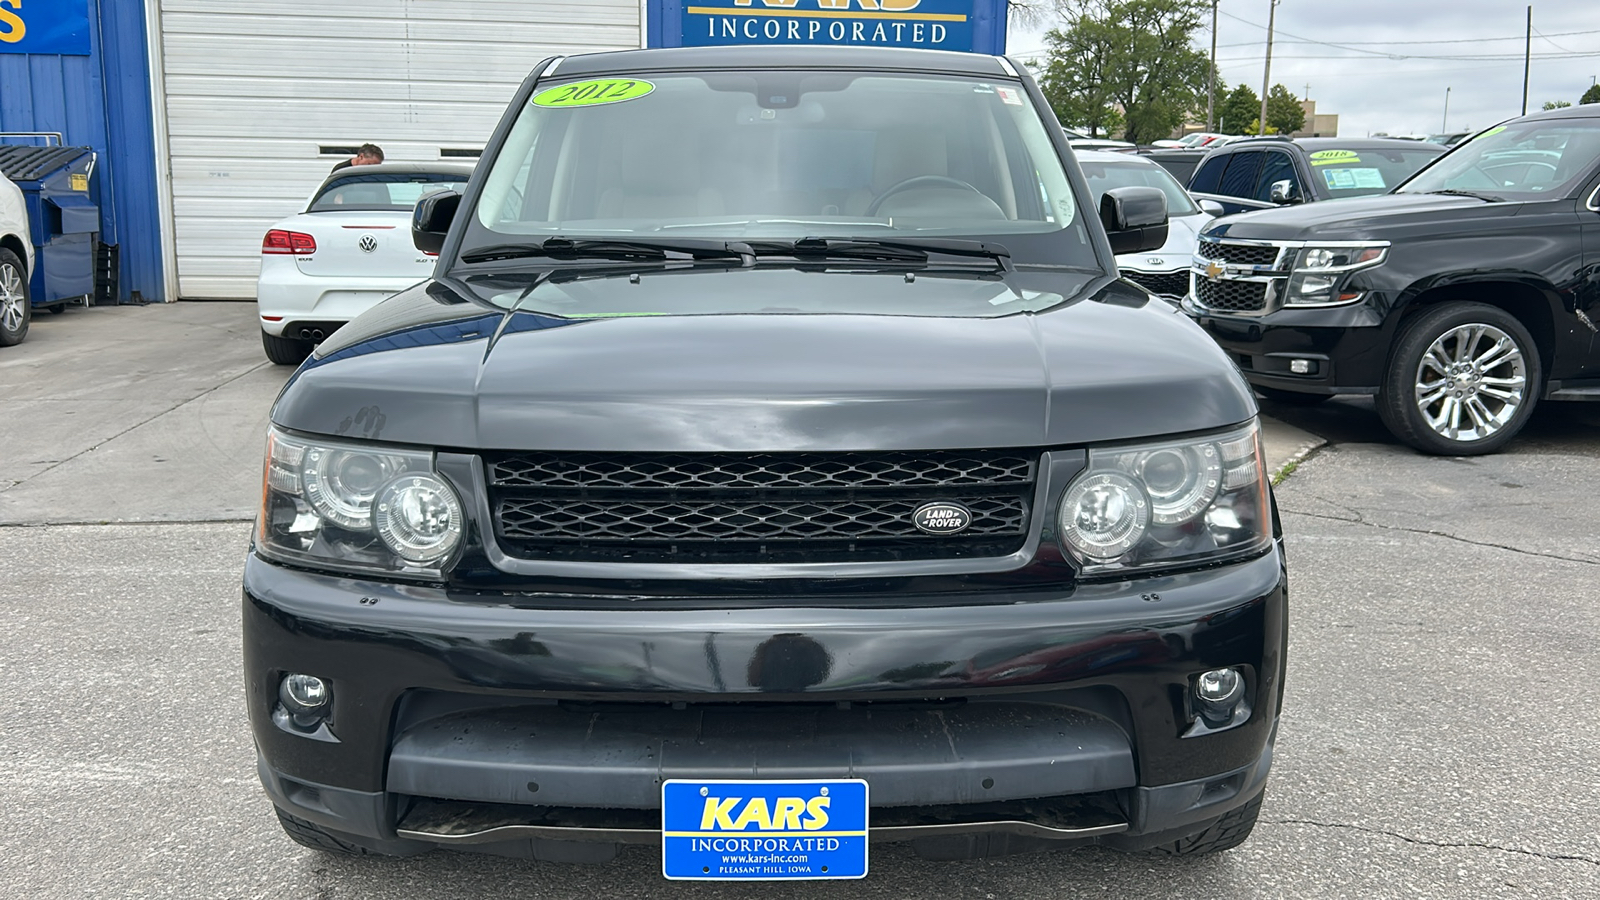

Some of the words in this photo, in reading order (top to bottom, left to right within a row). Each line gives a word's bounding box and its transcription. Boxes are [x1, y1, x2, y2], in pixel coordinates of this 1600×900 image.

[708, 17, 947, 43] INCORPORATED
[550, 81, 636, 103] 2012
[1320, 150, 1348, 158] 2018
[926, 510, 953, 519] LAND
[928, 519, 962, 527] ROVER
[700, 797, 831, 830] KARS
[691, 838, 840, 852] INCORPORATED
[719, 866, 761, 874] PLEASANT
[788, 865, 812, 873] IOWA
